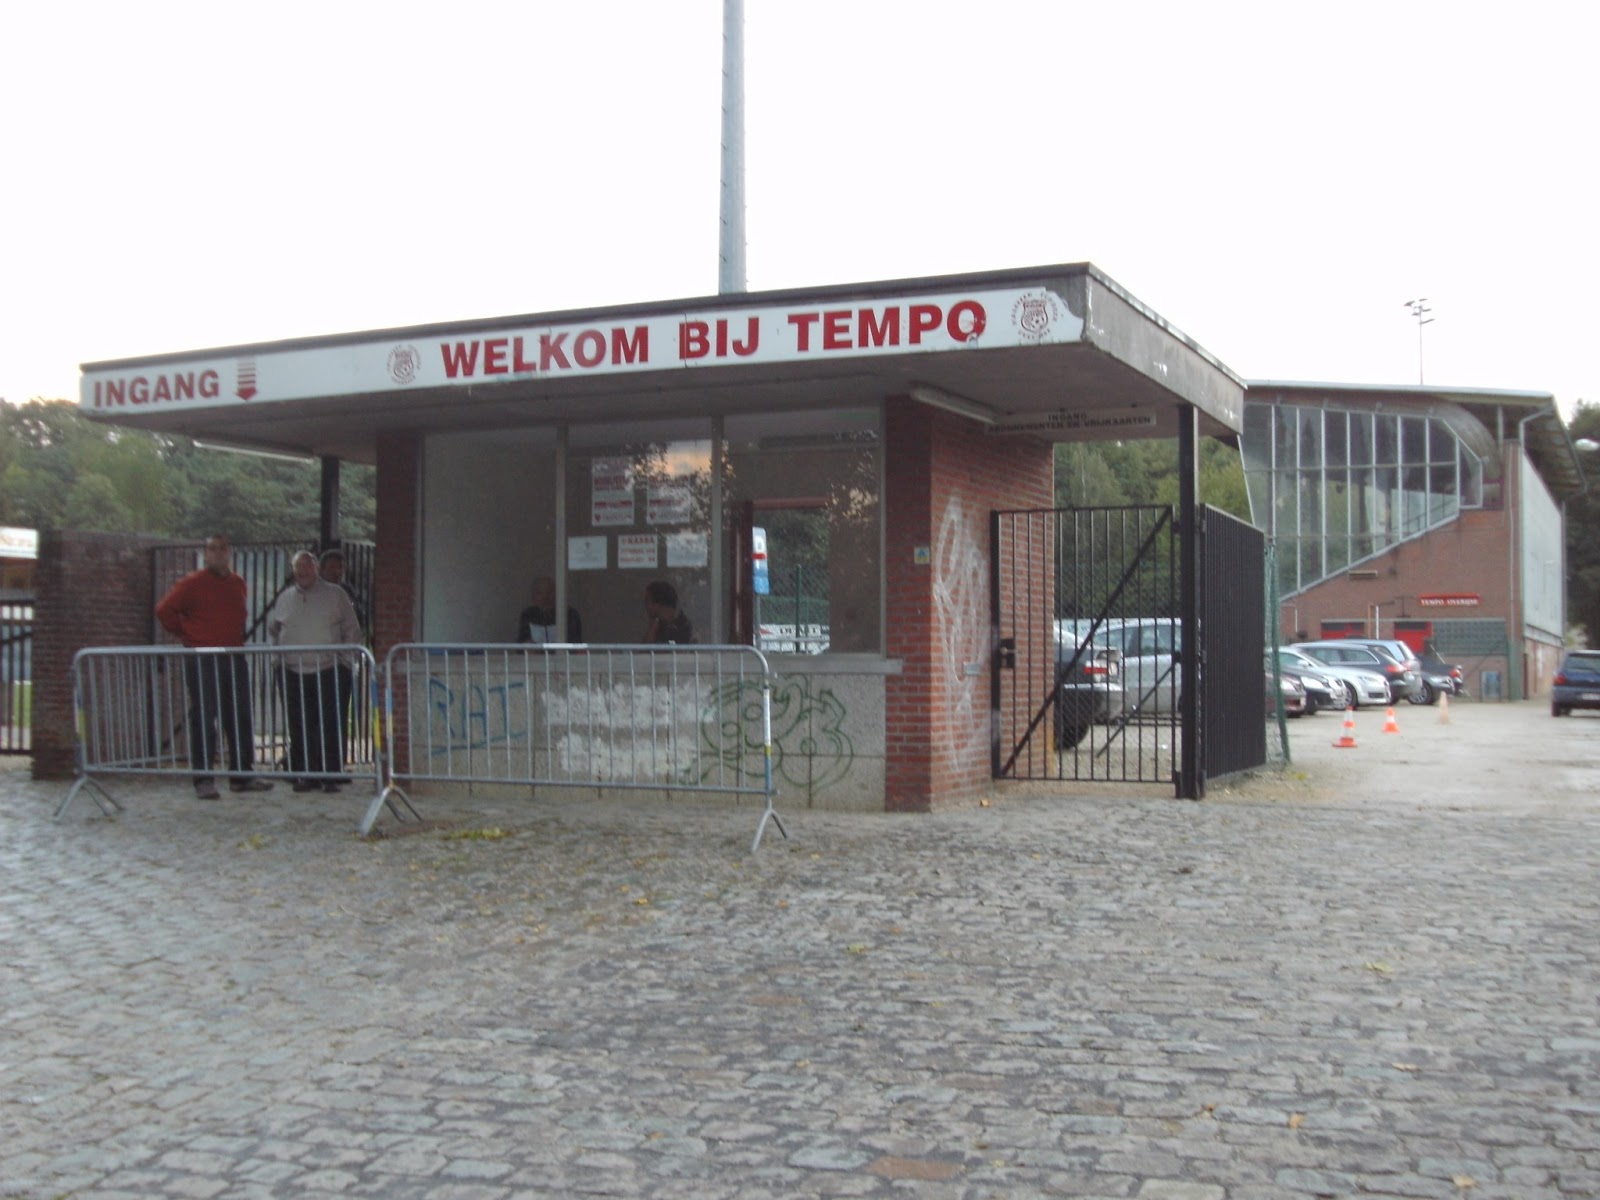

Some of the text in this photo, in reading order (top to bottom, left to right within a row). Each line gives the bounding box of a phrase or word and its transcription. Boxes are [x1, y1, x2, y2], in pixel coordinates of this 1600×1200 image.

[440, 325, 649, 378] WELKOM
[678, 316, 760, 361] BIJ
[787, 300, 986, 352] TEMPO
[94, 370, 220, 408] INGANG
